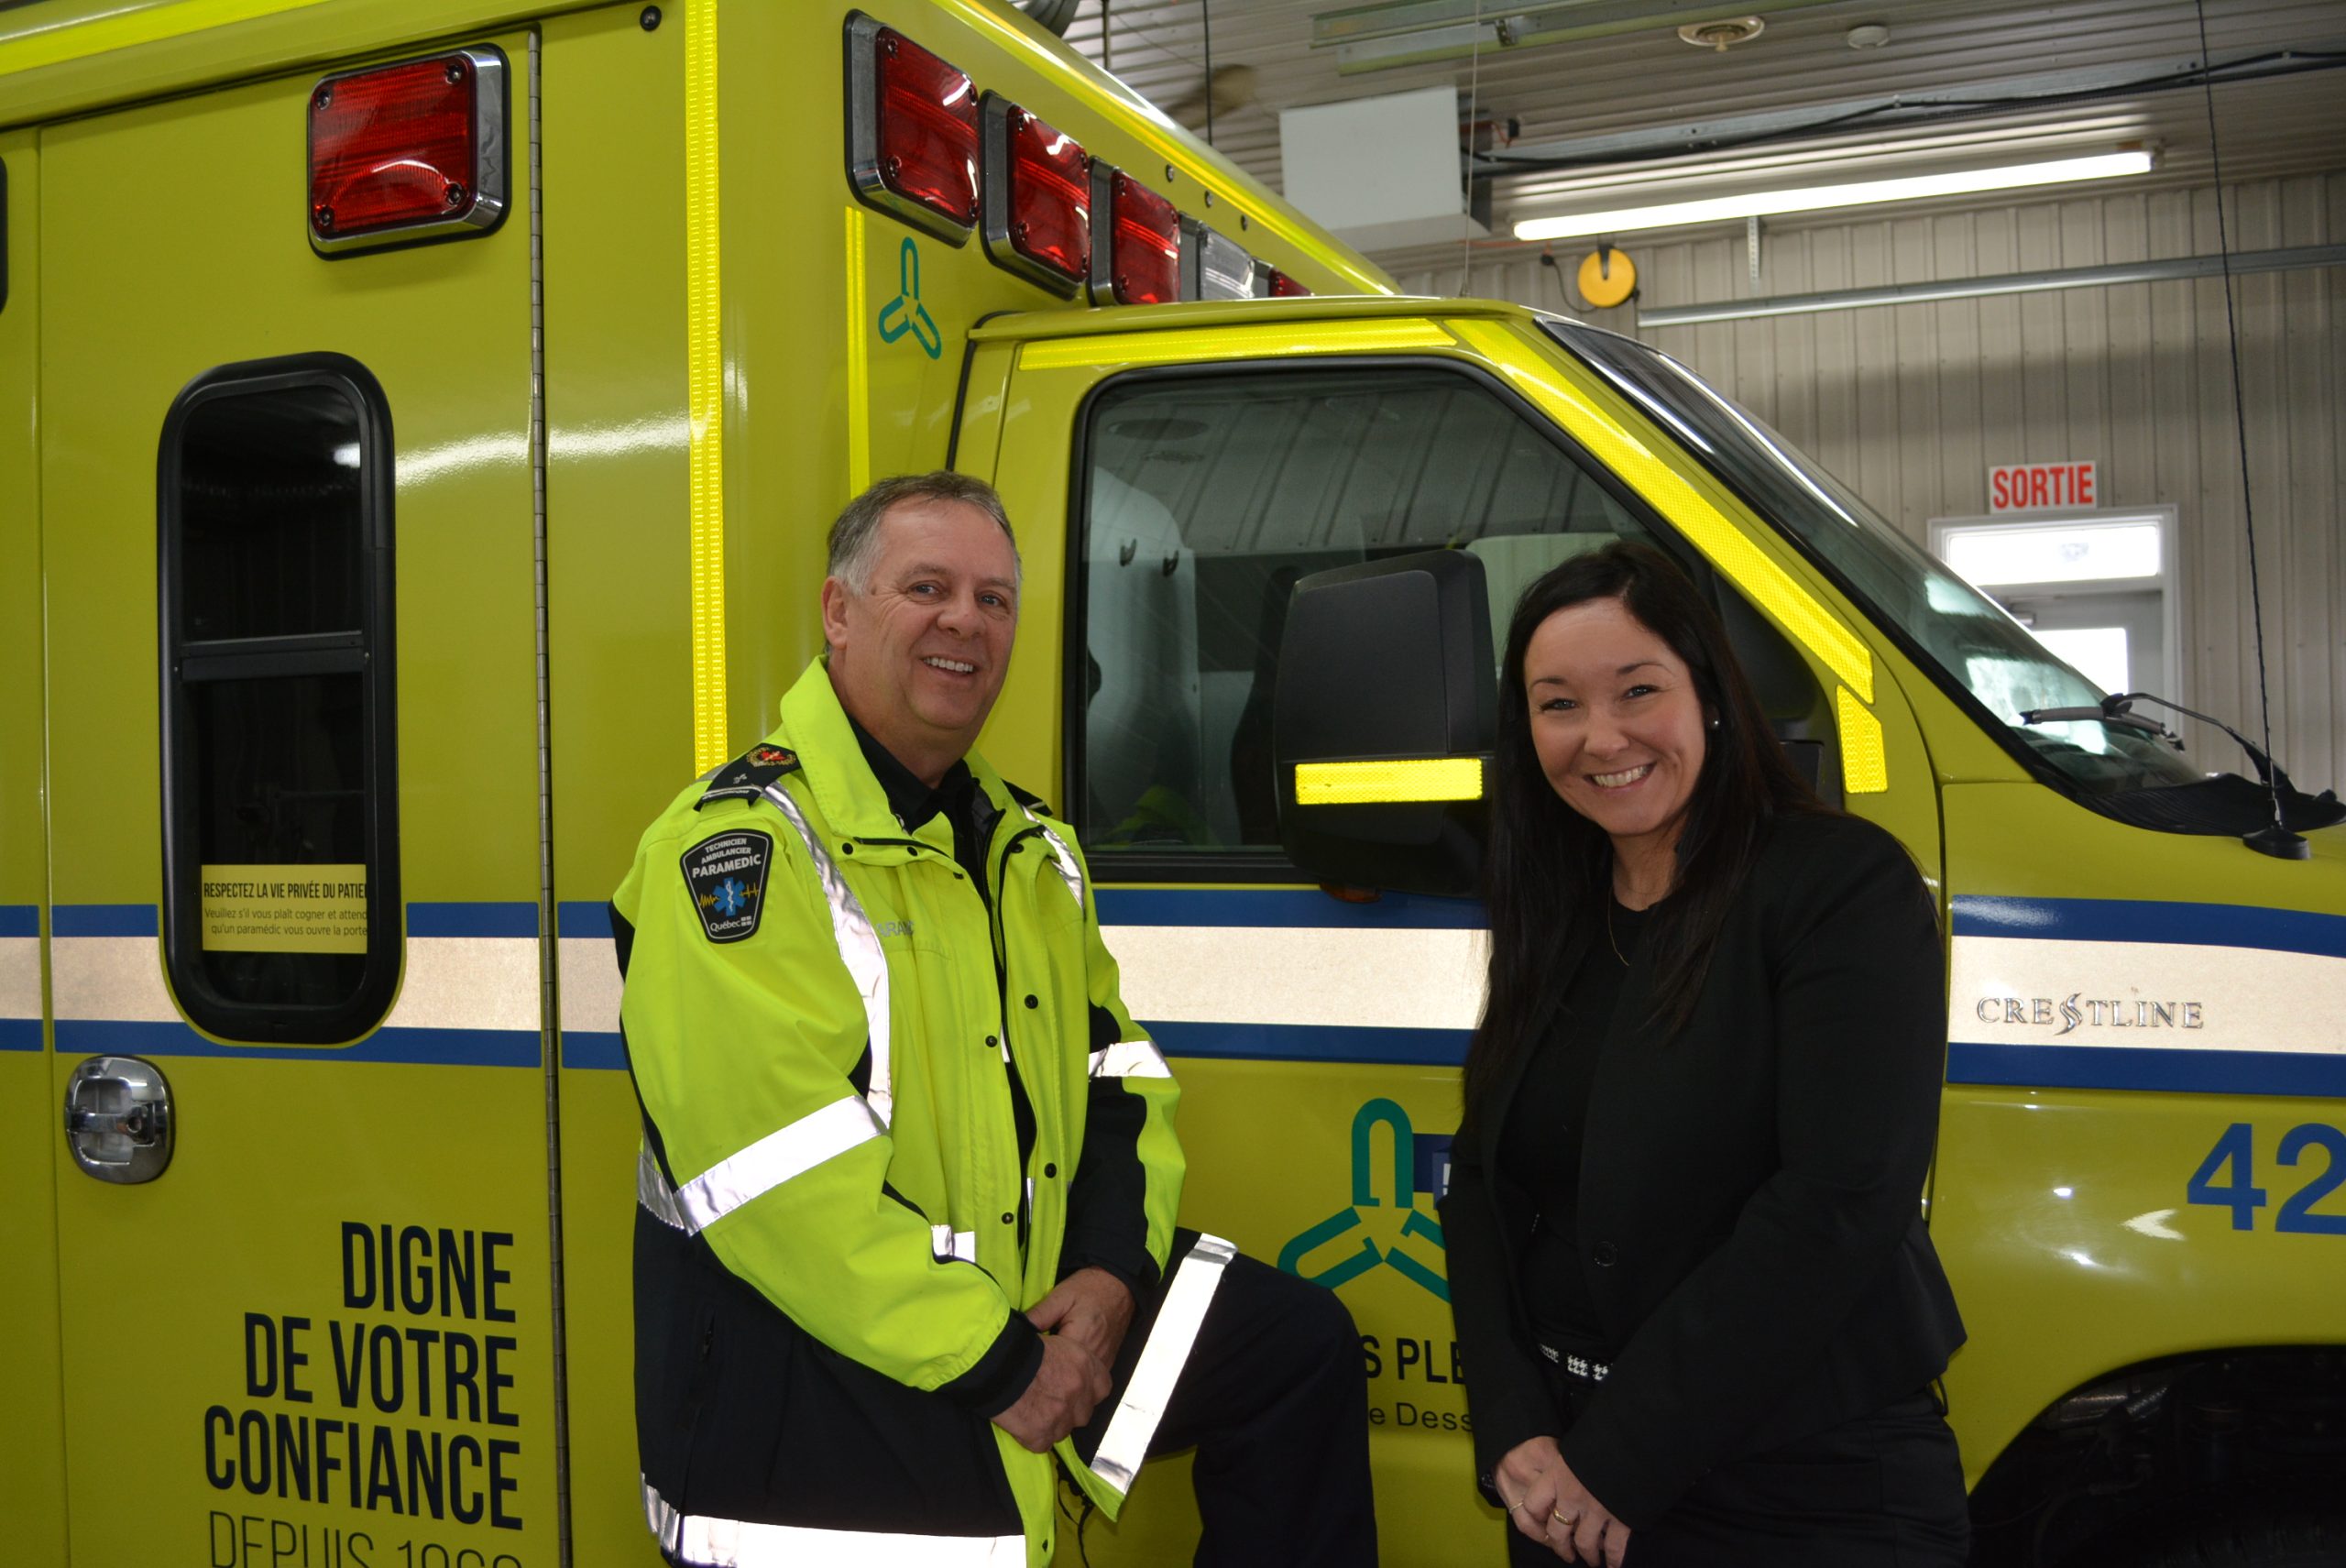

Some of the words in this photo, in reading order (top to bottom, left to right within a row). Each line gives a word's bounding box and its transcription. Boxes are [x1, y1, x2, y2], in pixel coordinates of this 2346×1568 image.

[1993, 464, 2093, 509] SORTIE
[701, 847, 751, 864] AMBULANCIER
[705, 838, 747, 853] TECHNICIEN
[692, 854, 762, 878] PARAMEDIC
[204, 883, 254, 898] RESPECTEZ
[257, 883, 269, 898] LA
[270, 883, 285, 898] VIE
[288, 881, 320, 898] PRIVÉE
[323, 883, 334, 898] DU
[204, 908, 236, 918] Veuillez
[239, 908, 249, 918] s'il
[252, 910, 271, 919] vous
[295, 910, 324, 922] cogner
[328, 909, 336, 920] et
[212, 924, 236, 935] qu'un
[237, 923, 280, 937] paramédic
[283, 926, 303, 936] vous
[306, 927, 330, 936] ouvre
[333, 925, 341, 936] la
[710, 919, 740, 932] Québec
[1977, 992, 2204, 1036] CRESTLINE
[2187, 1123, 2346, 1235] 42
[342, 1222, 516, 1323] DIGNE
[245, 1312, 312, 1403] DE
[329, 1320, 519, 1427] VOTRE
[1396, 1337, 1467, 1385] PLE
[1396, 1402, 1473, 1432] Dess
[204, 1405, 523, 1530] CONFIANCE
[210, 1511, 374, 1568] DEPUIS
